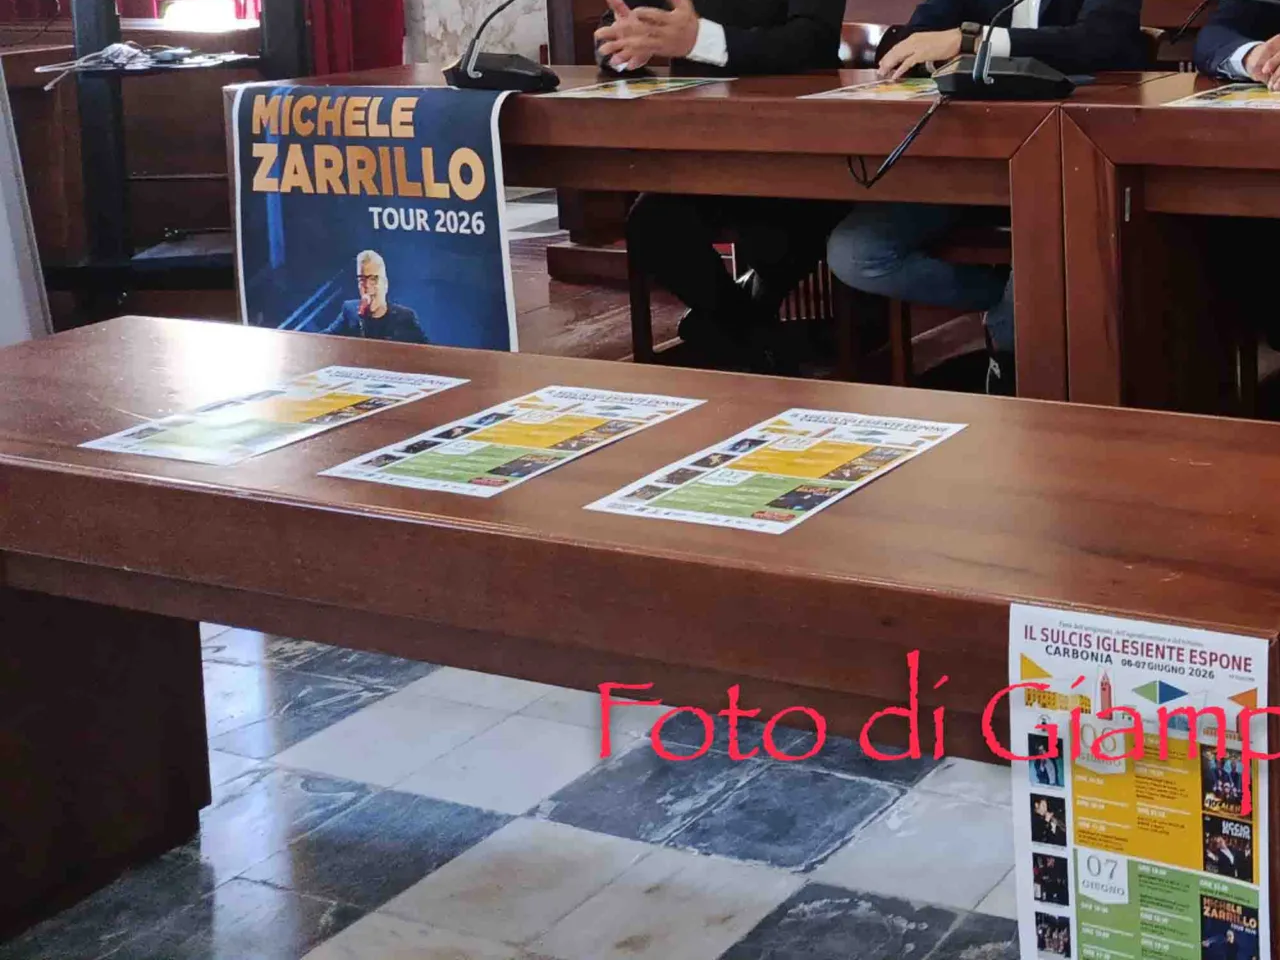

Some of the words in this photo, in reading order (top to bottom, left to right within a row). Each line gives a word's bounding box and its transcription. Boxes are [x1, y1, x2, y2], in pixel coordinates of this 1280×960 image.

[251, 94, 420, 138] MICHELE
[252, 143, 486, 201] ZARRILLO
[369, 207, 430, 231] TOUR
[434, 209, 485, 235] 2026
[1024, 625, 1037, 641] IL
[1040, 627, 1092, 648] SULCIS
[1096, 634, 1185, 663] IGLESIENTE
[1189, 650, 1253, 673] ESPONE
[1045, 645, 1113, 665] CARBONIA
[1121, 658, 1147, 670] 06-07
[1147, 662, 1186, 676] GIUGNO
[1188, 668, 1215, 680] 2026
[1222, 821, 1251, 834] UCCIO
[1086, 854, 1119, 877] 07
[1082, 879, 1126, 897] GIUGNO
[1203, 897, 1243, 915] MICHELE
[1203, 904, 1257, 928] ZARRILLO
